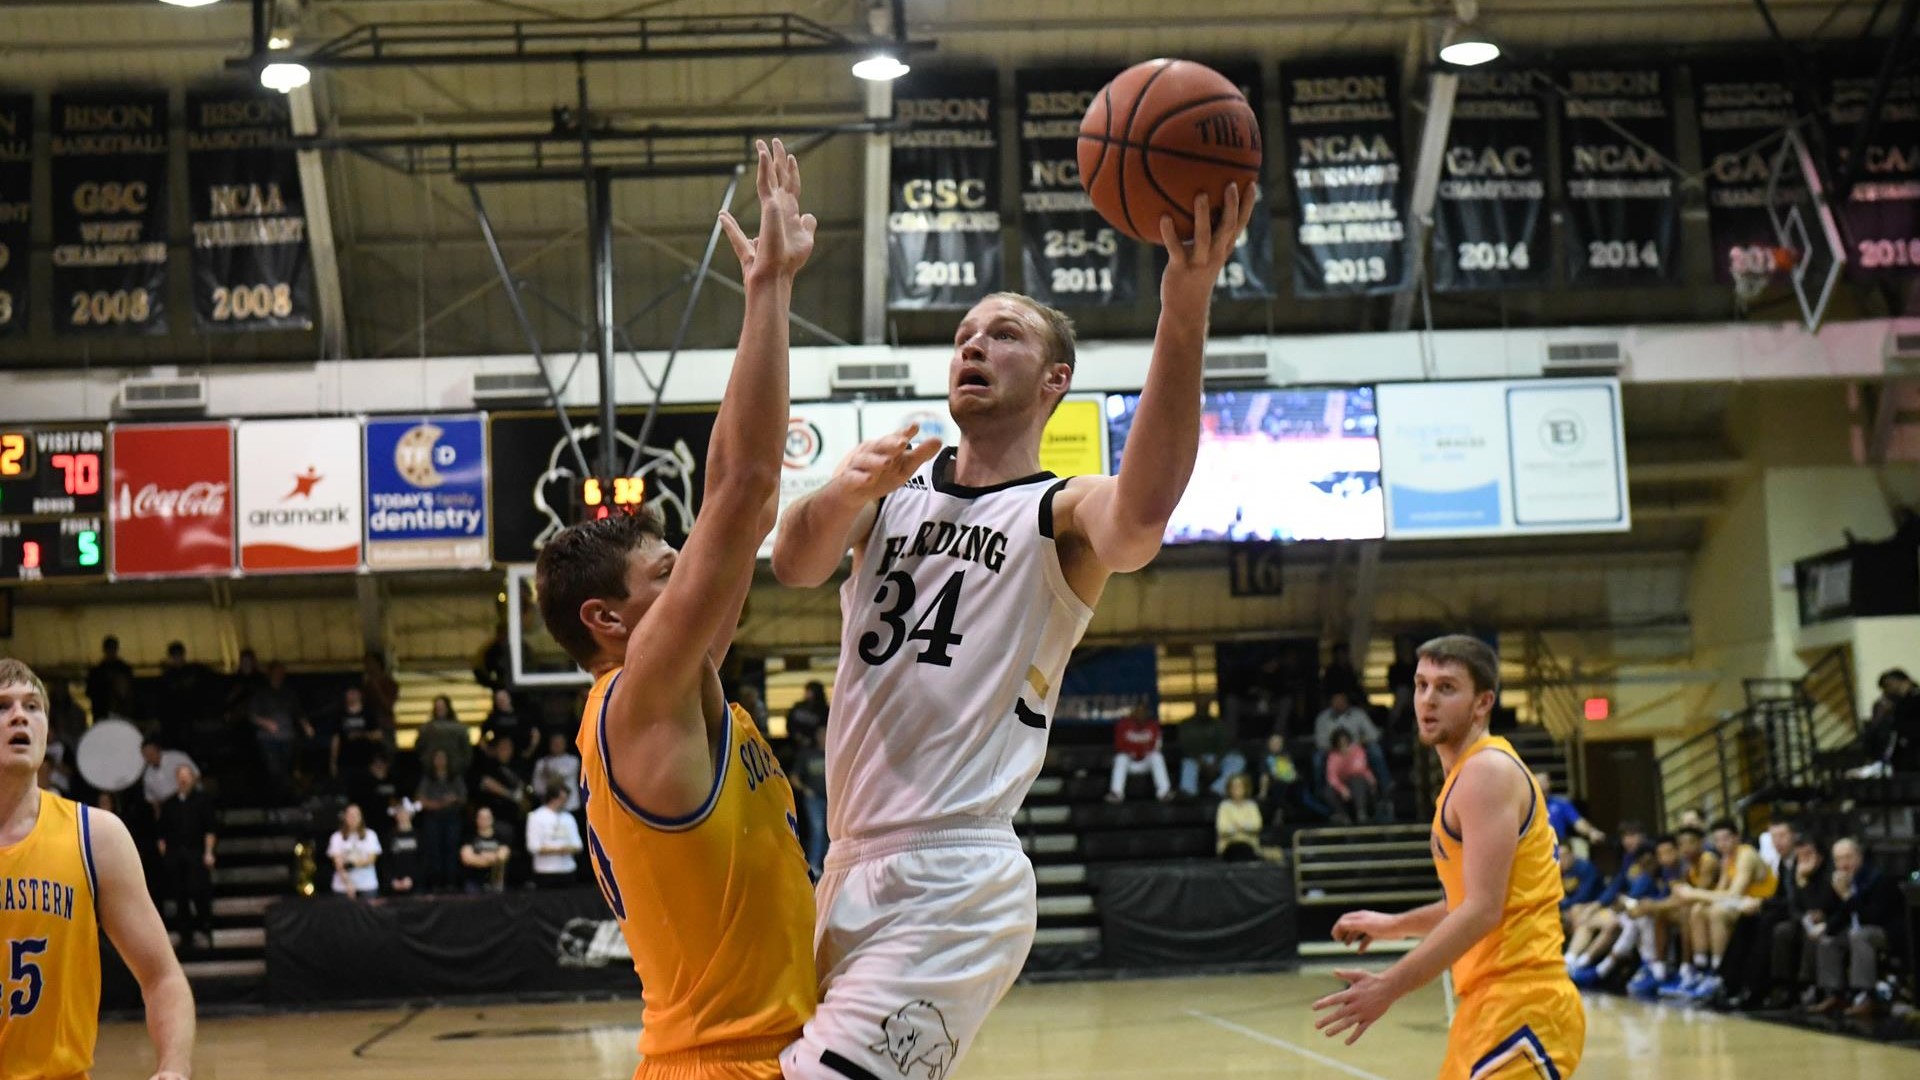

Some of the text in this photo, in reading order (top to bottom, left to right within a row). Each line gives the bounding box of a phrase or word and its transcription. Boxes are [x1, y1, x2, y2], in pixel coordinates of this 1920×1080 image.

[1300, 135, 1393, 163] NCAA
[1447, 146, 1533, 176] GAC
[73, 181, 147, 214] GSC
[211, 183, 287, 216] NCAA
[904, 178, 987, 210] GSC
[1459, 241, 1530, 270] 2014
[1588, 240, 1659, 268] 2014
[915, 261, 977, 287] 2011
[1052, 267, 1114, 292] 2011
[1324, 256, 1386, 284] 2013
[71, 287, 149, 325] 2008
[212, 282, 293, 320] 2008
[37, 431, 104, 451] VISITOR
[52, 454, 99, 495] 70
[248, 503, 350, 529] aramark
[370, 506, 482, 534] dentistry
[78, 530, 99, 566] 5
[858, 568, 966, 668] 34
